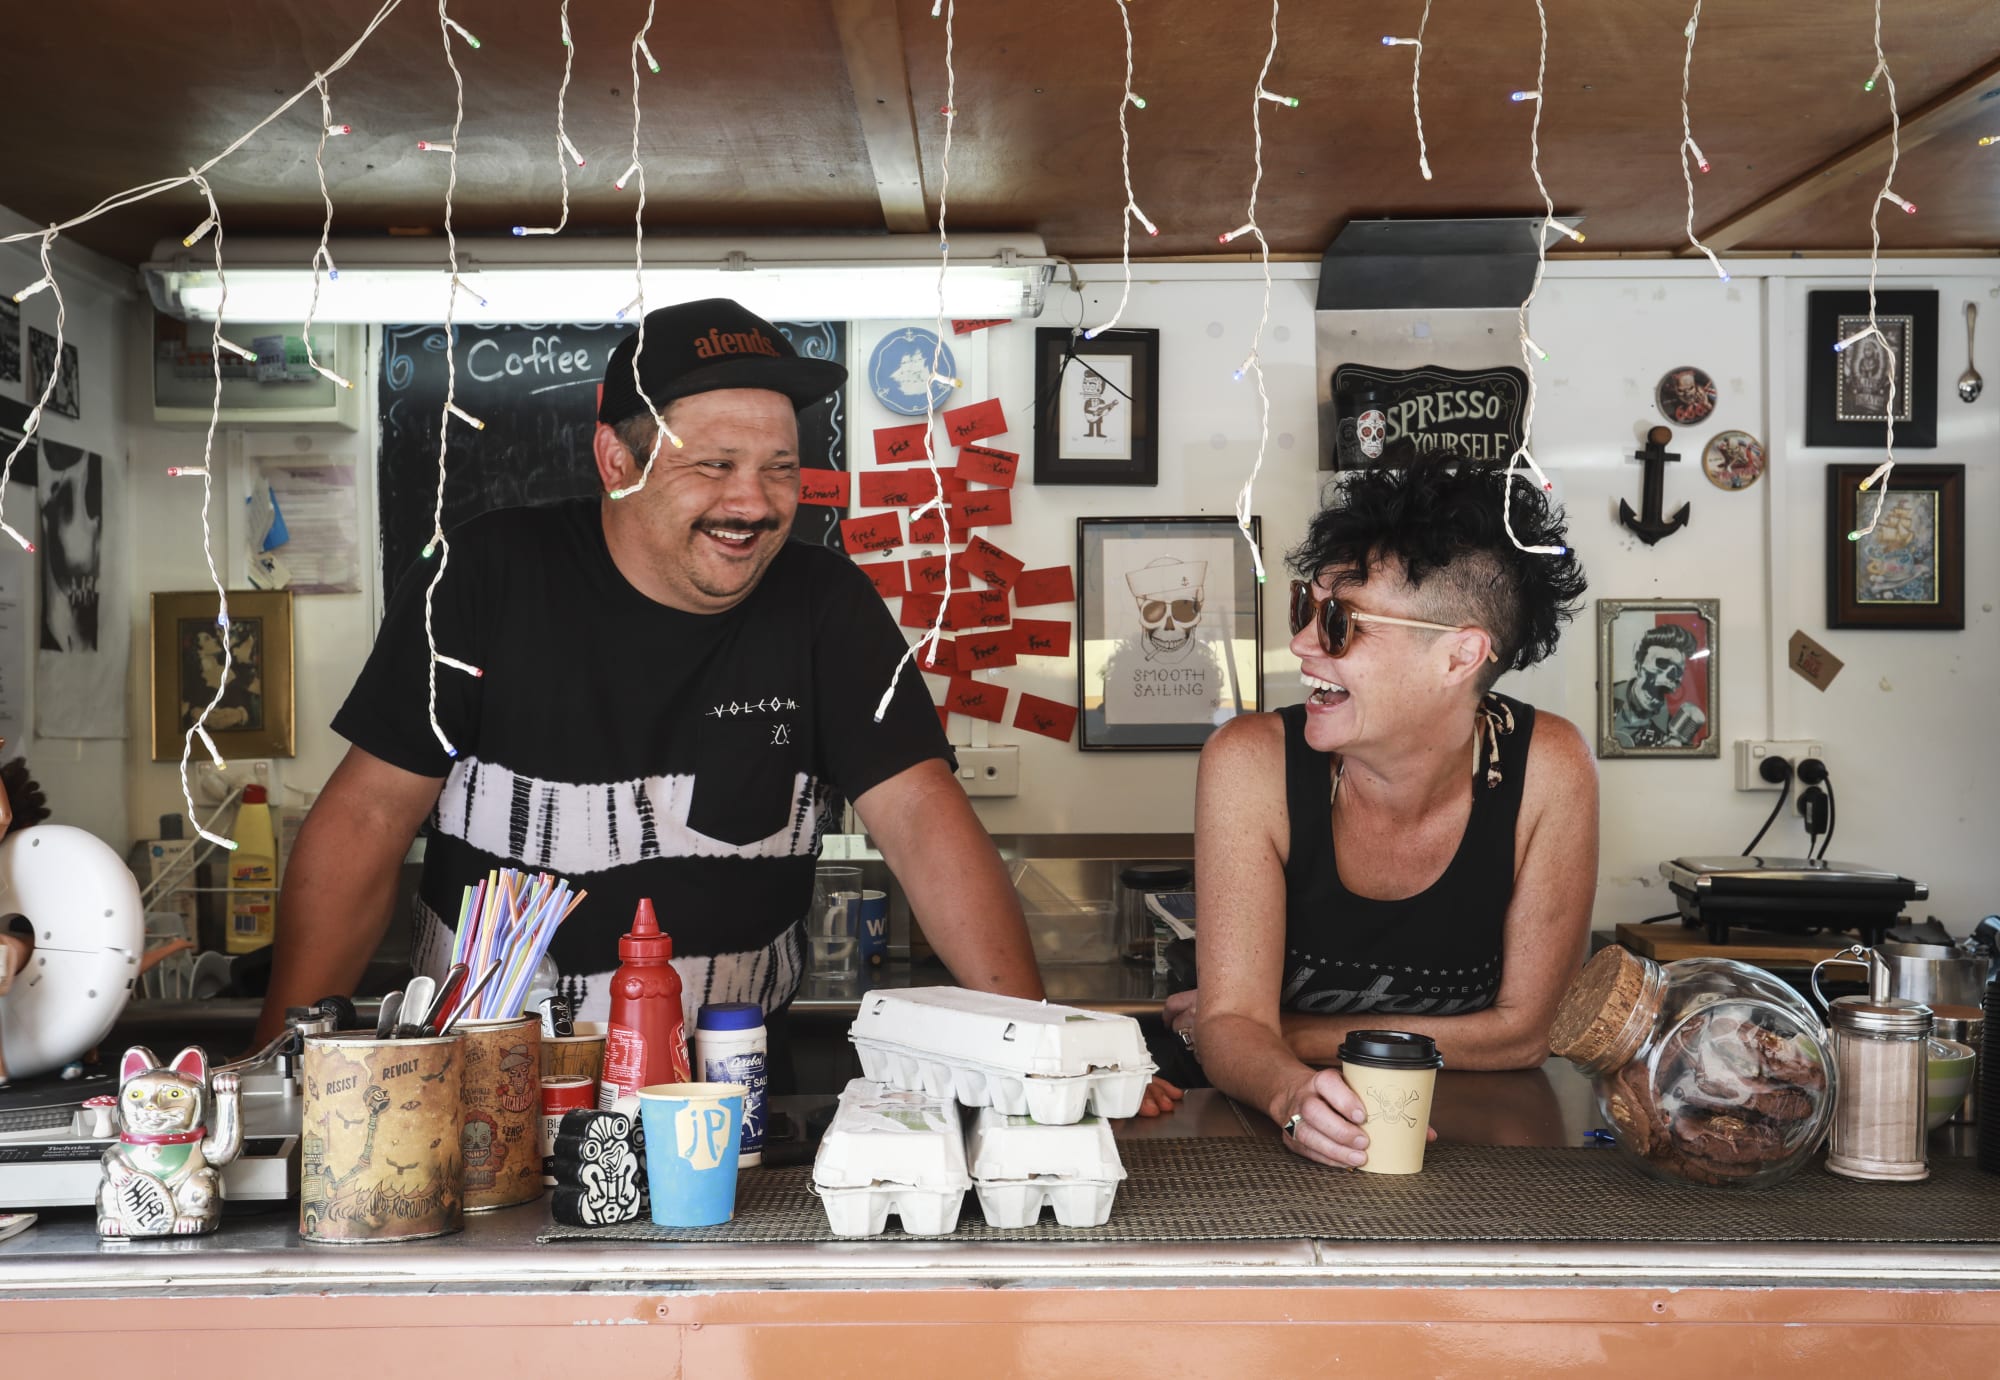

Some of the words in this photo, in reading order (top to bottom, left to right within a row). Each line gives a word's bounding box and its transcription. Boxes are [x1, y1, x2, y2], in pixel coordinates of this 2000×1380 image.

[466, 336, 593, 382] Coffee
[1386, 390, 1500, 444] SPRESSO
[1410, 432, 1510, 461] YOURSELF
[1132, 668, 1205, 682] SMOOTH
[1133, 682, 1203, 698] SAILING
[713, 696, 797, 718] VOLCOM
[1413, 978, 1496, 993] AOTEAR
[382, 1058, 419, 1081] REVOLT
[325, 1075, 358, 1095] RESIST
